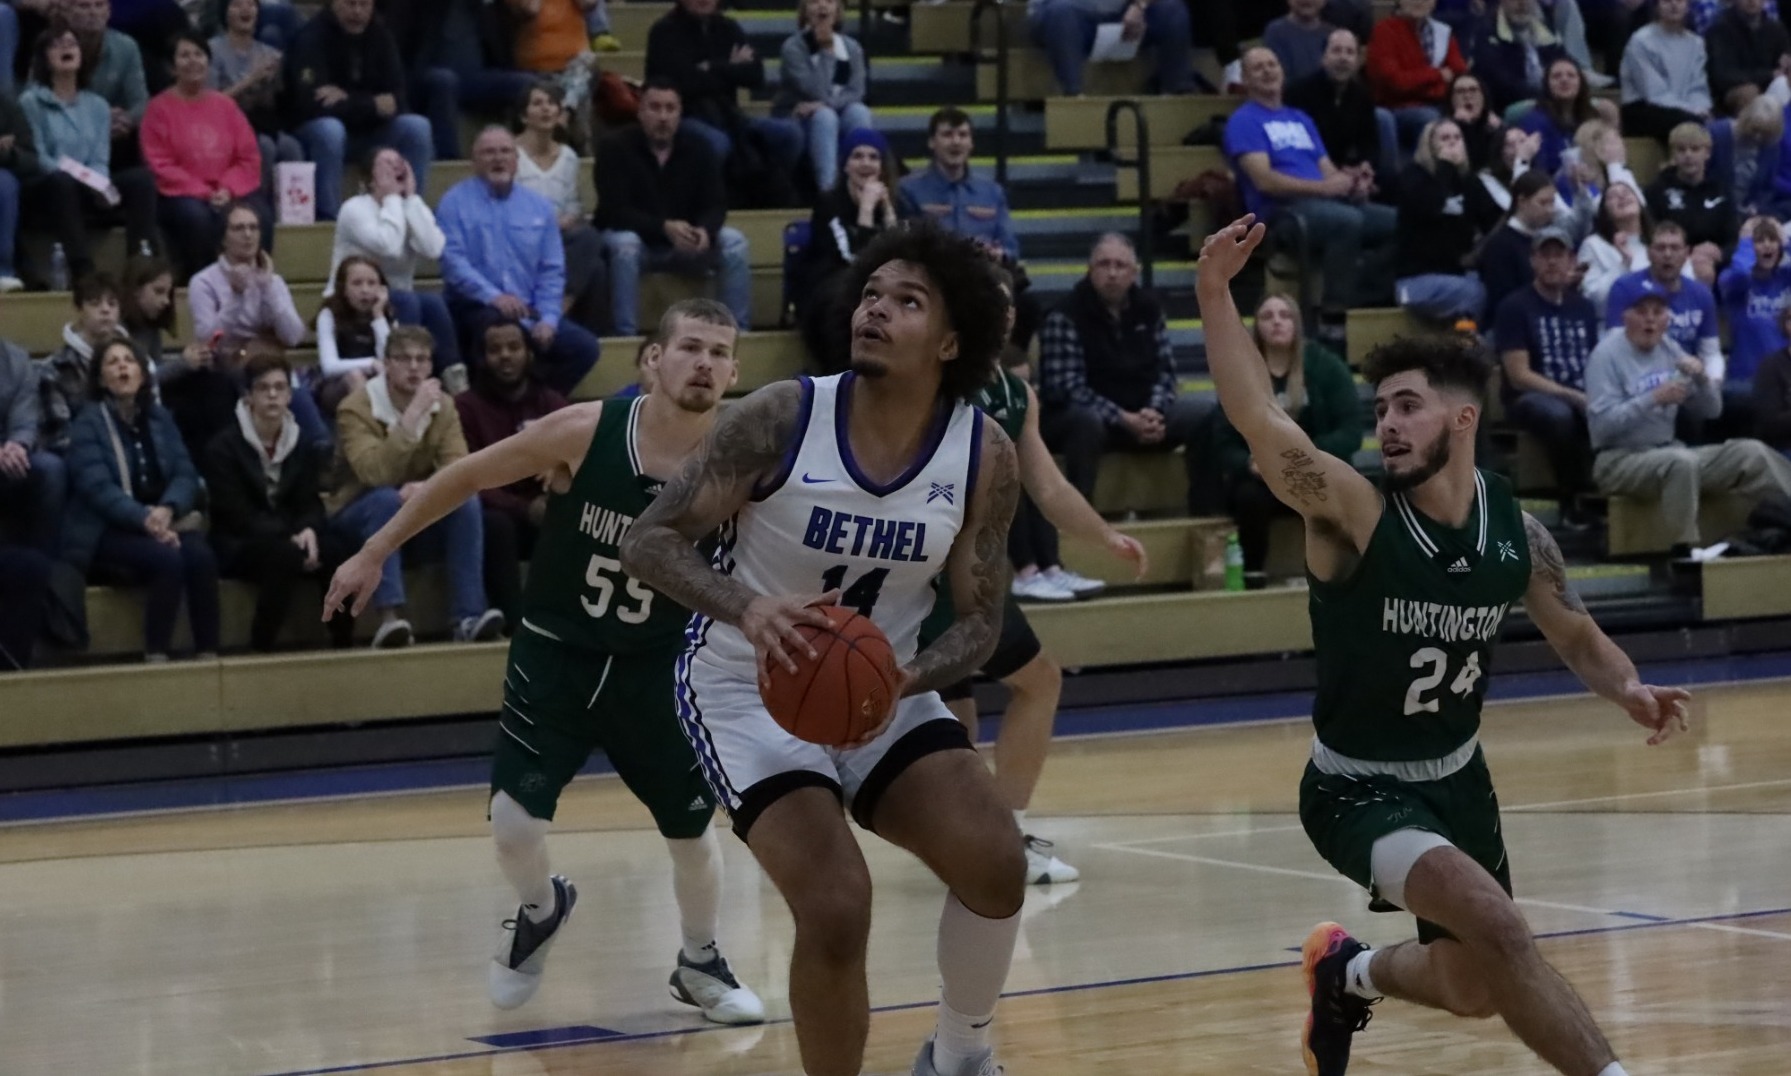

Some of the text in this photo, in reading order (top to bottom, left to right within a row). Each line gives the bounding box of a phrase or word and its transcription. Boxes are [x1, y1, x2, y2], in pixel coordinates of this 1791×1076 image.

[579, 501, 637, 547] HUNT
[803, 506, 928, 562] BETHEL
[580, 553, 655, 625] 55
[822, 565, 890, 619] 14
[1382, 597, 1508, 642] HUNTINGTON
[1403, 646, 1482, 716] 24
